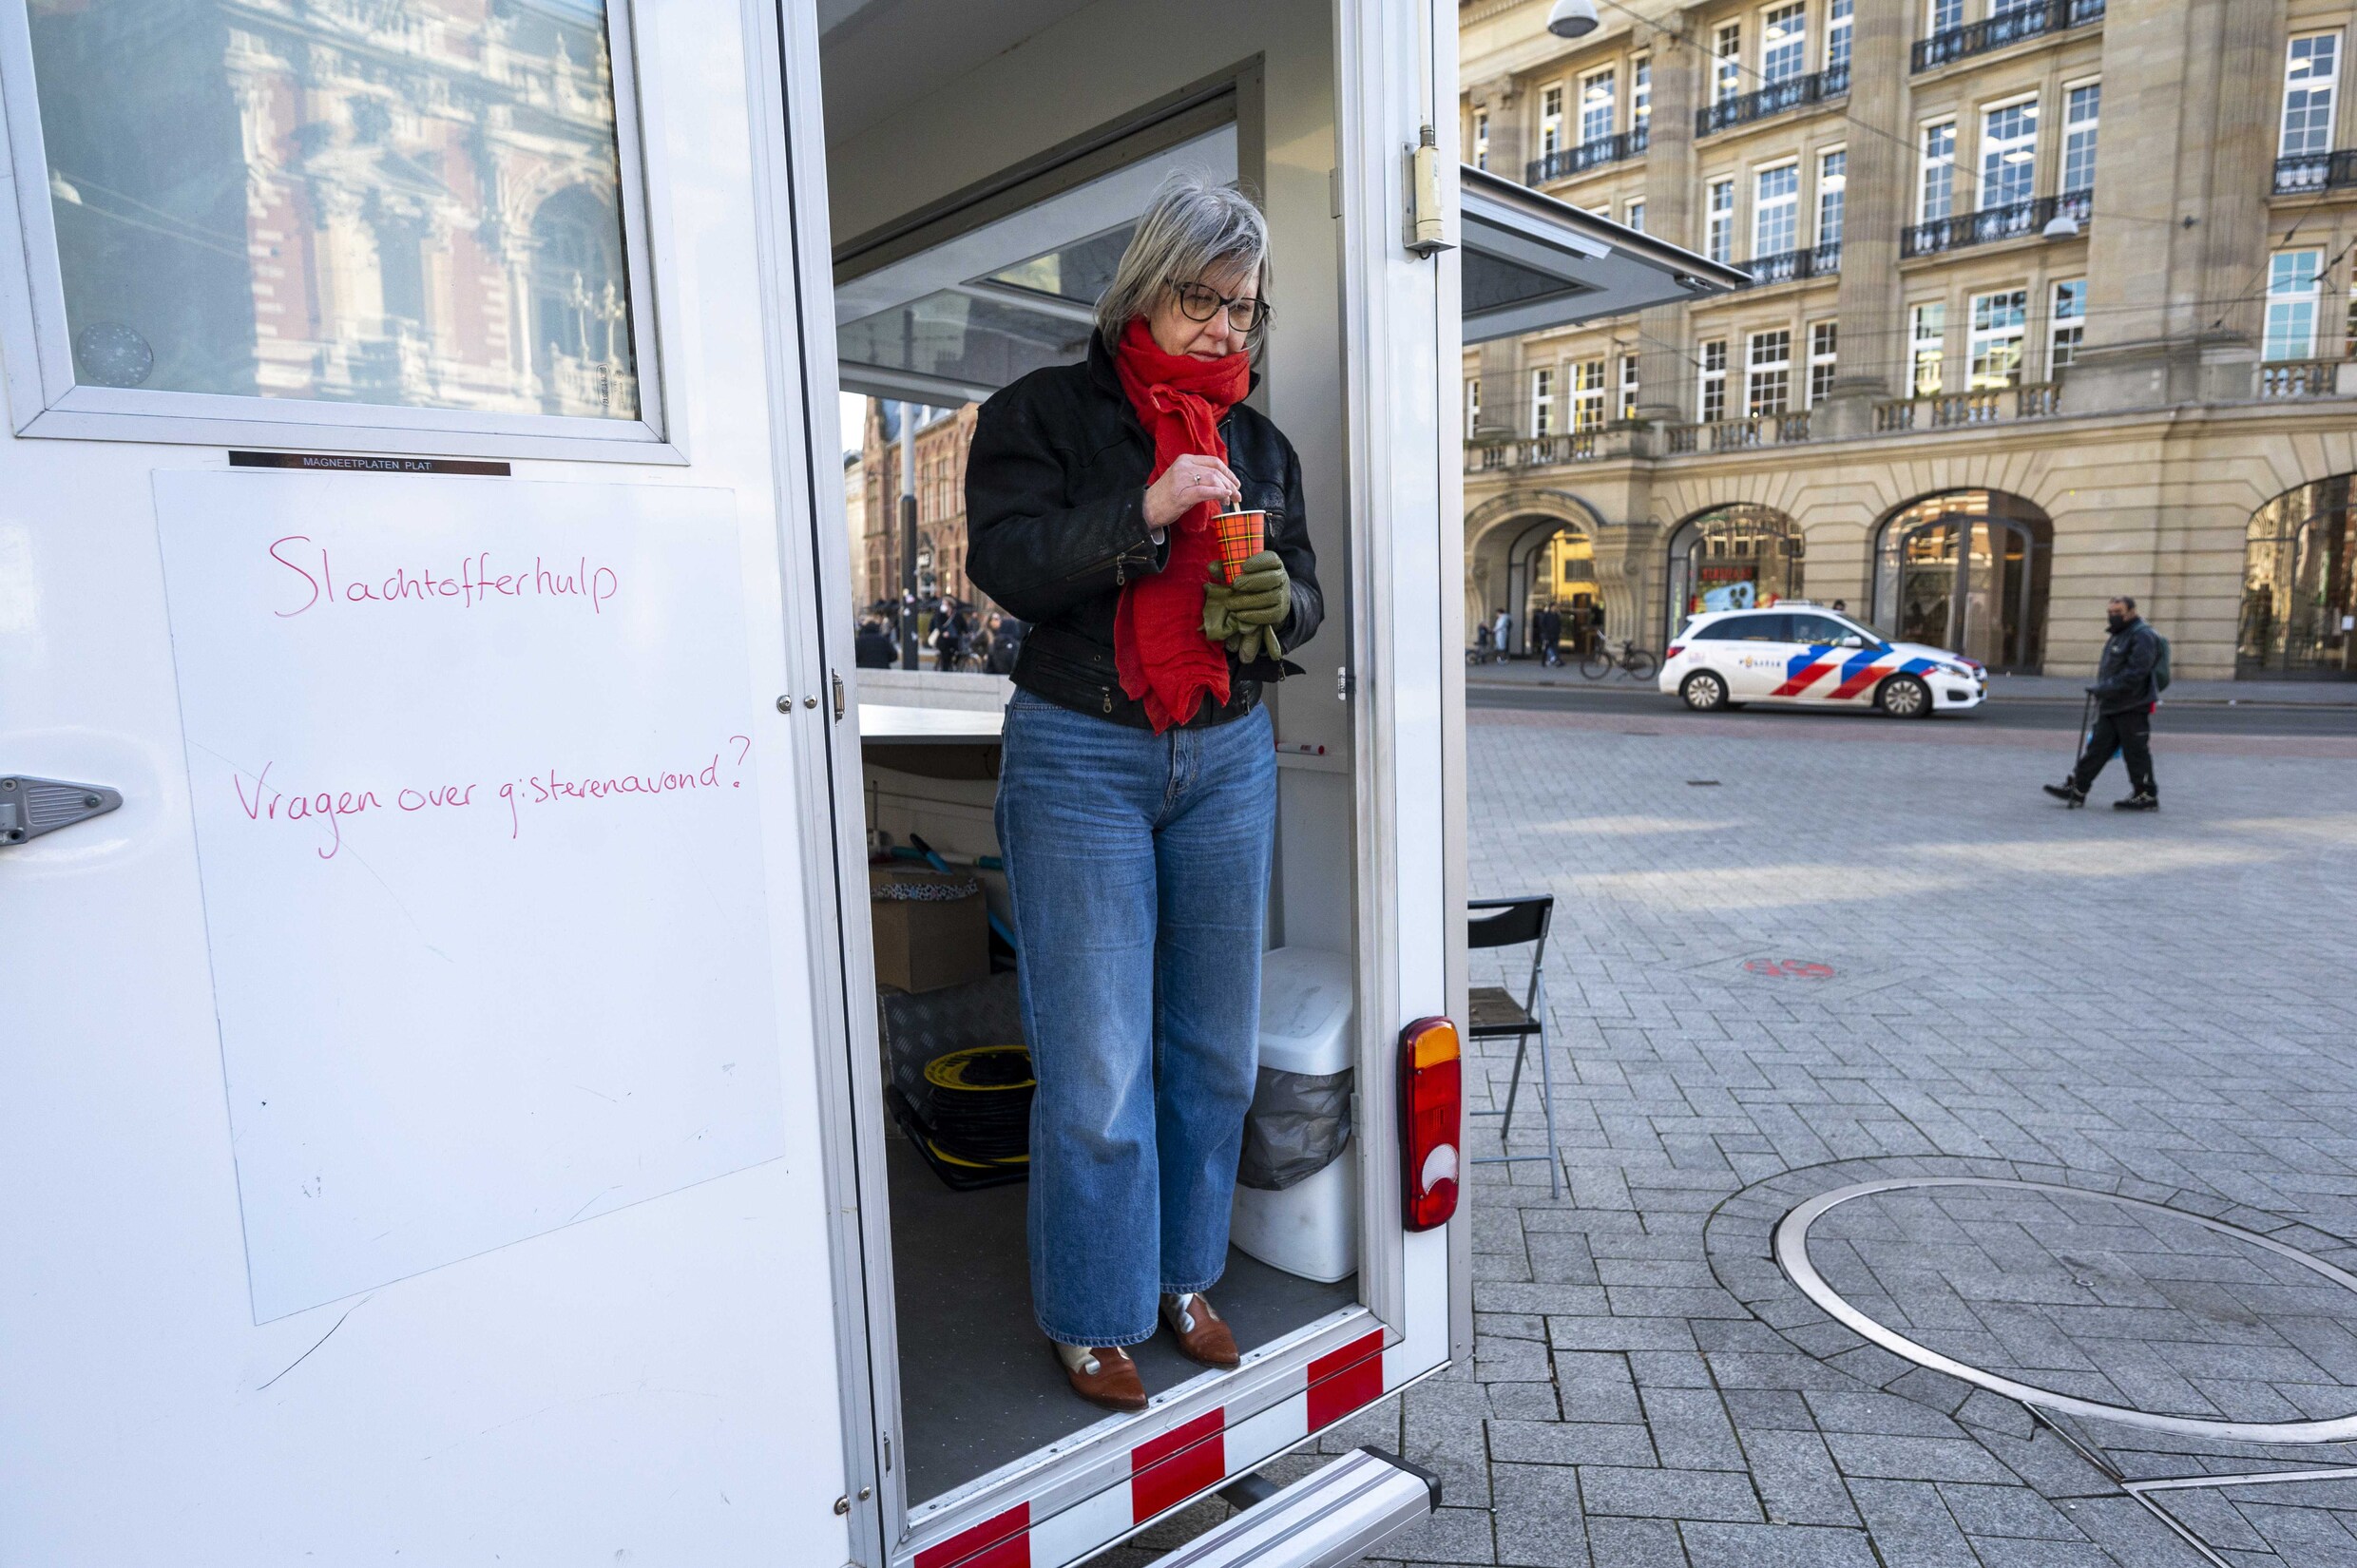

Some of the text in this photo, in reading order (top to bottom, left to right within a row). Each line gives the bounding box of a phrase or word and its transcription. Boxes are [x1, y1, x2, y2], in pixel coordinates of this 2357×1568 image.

[303, 457, 431, 470] MAGNEETPLATEN PLAT
[269, 535, 619, 618] Slachtofferhulp
[234, 735, 751, 860] Vragen over gisterenavond?
